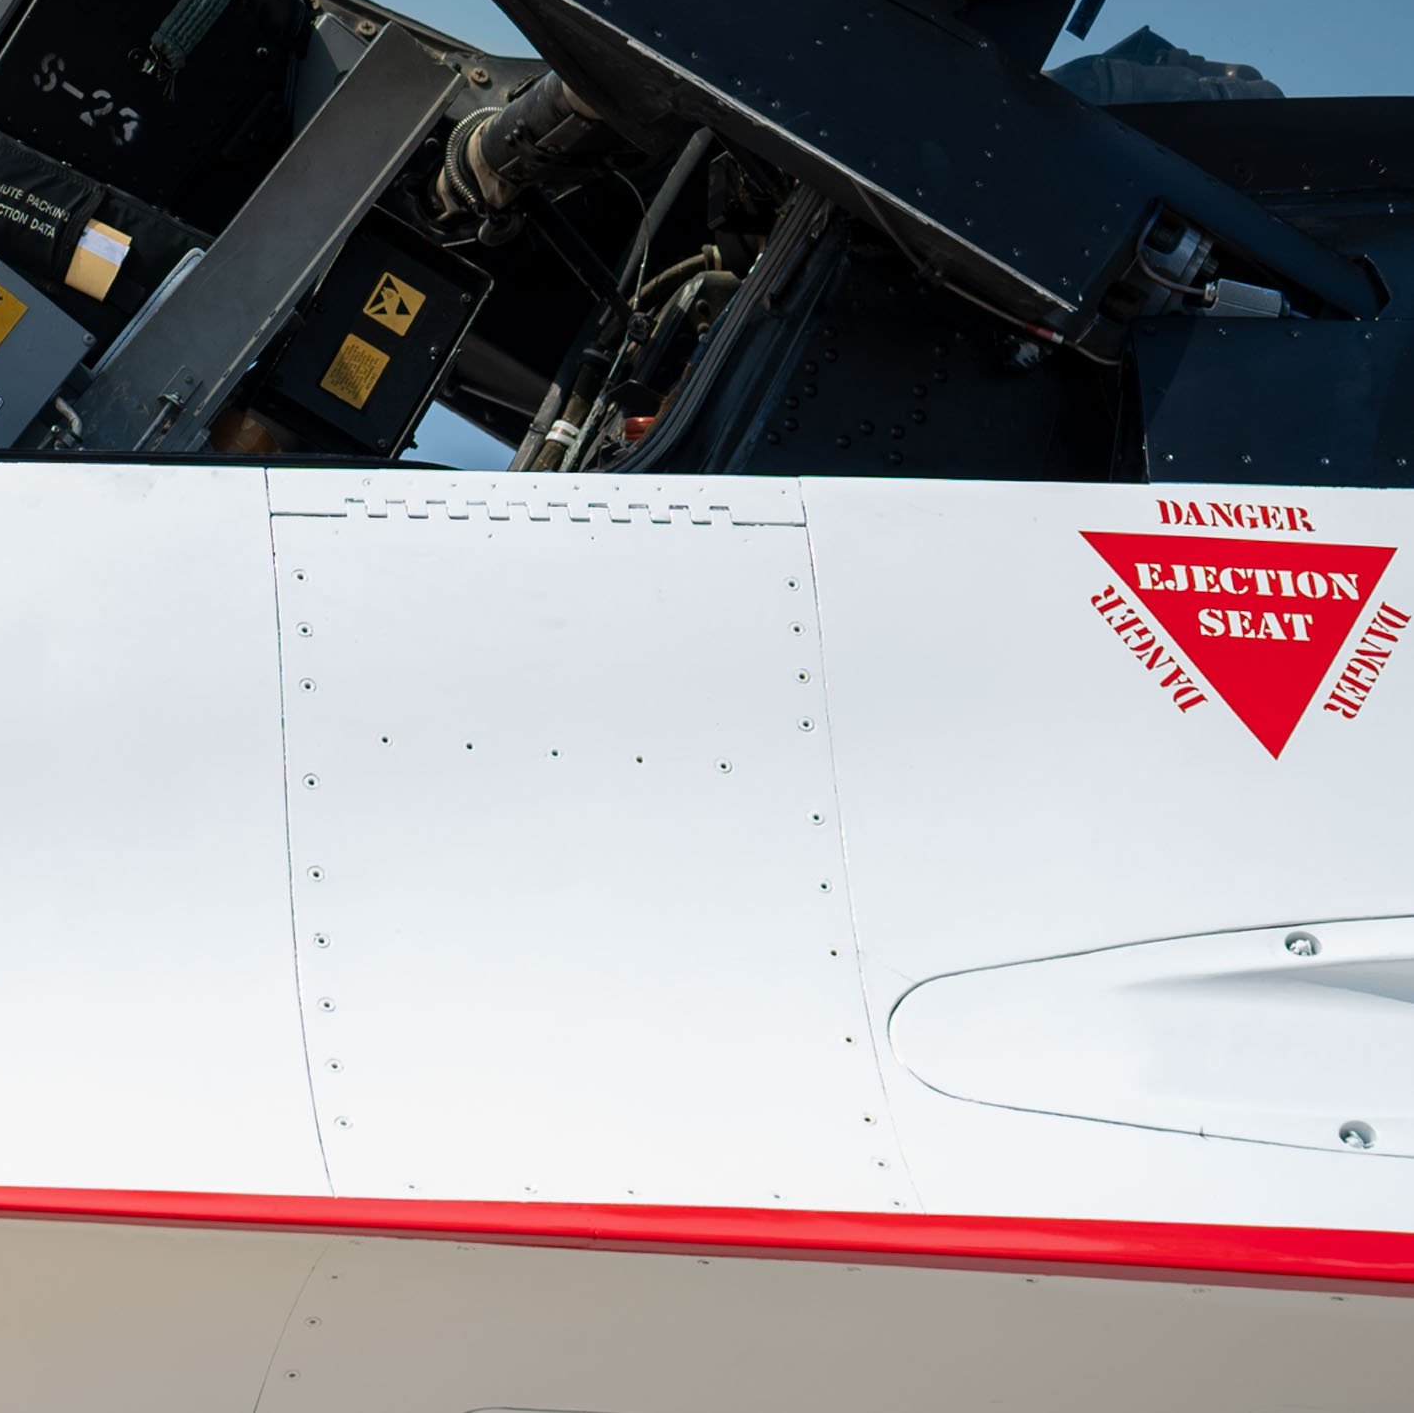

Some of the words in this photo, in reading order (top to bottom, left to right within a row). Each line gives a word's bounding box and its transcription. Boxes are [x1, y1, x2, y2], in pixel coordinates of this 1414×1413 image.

[31, 218, 55, 238] DATA
[1158, 500, 1314, 531] DANGER
[1135, 563, 1359, 600] EJECTION
[1198, 609, 1313, 641] SEAT
[1091, 584, 1208, 713] DANGER
[1323, 602, 1412, 720] DANGER
